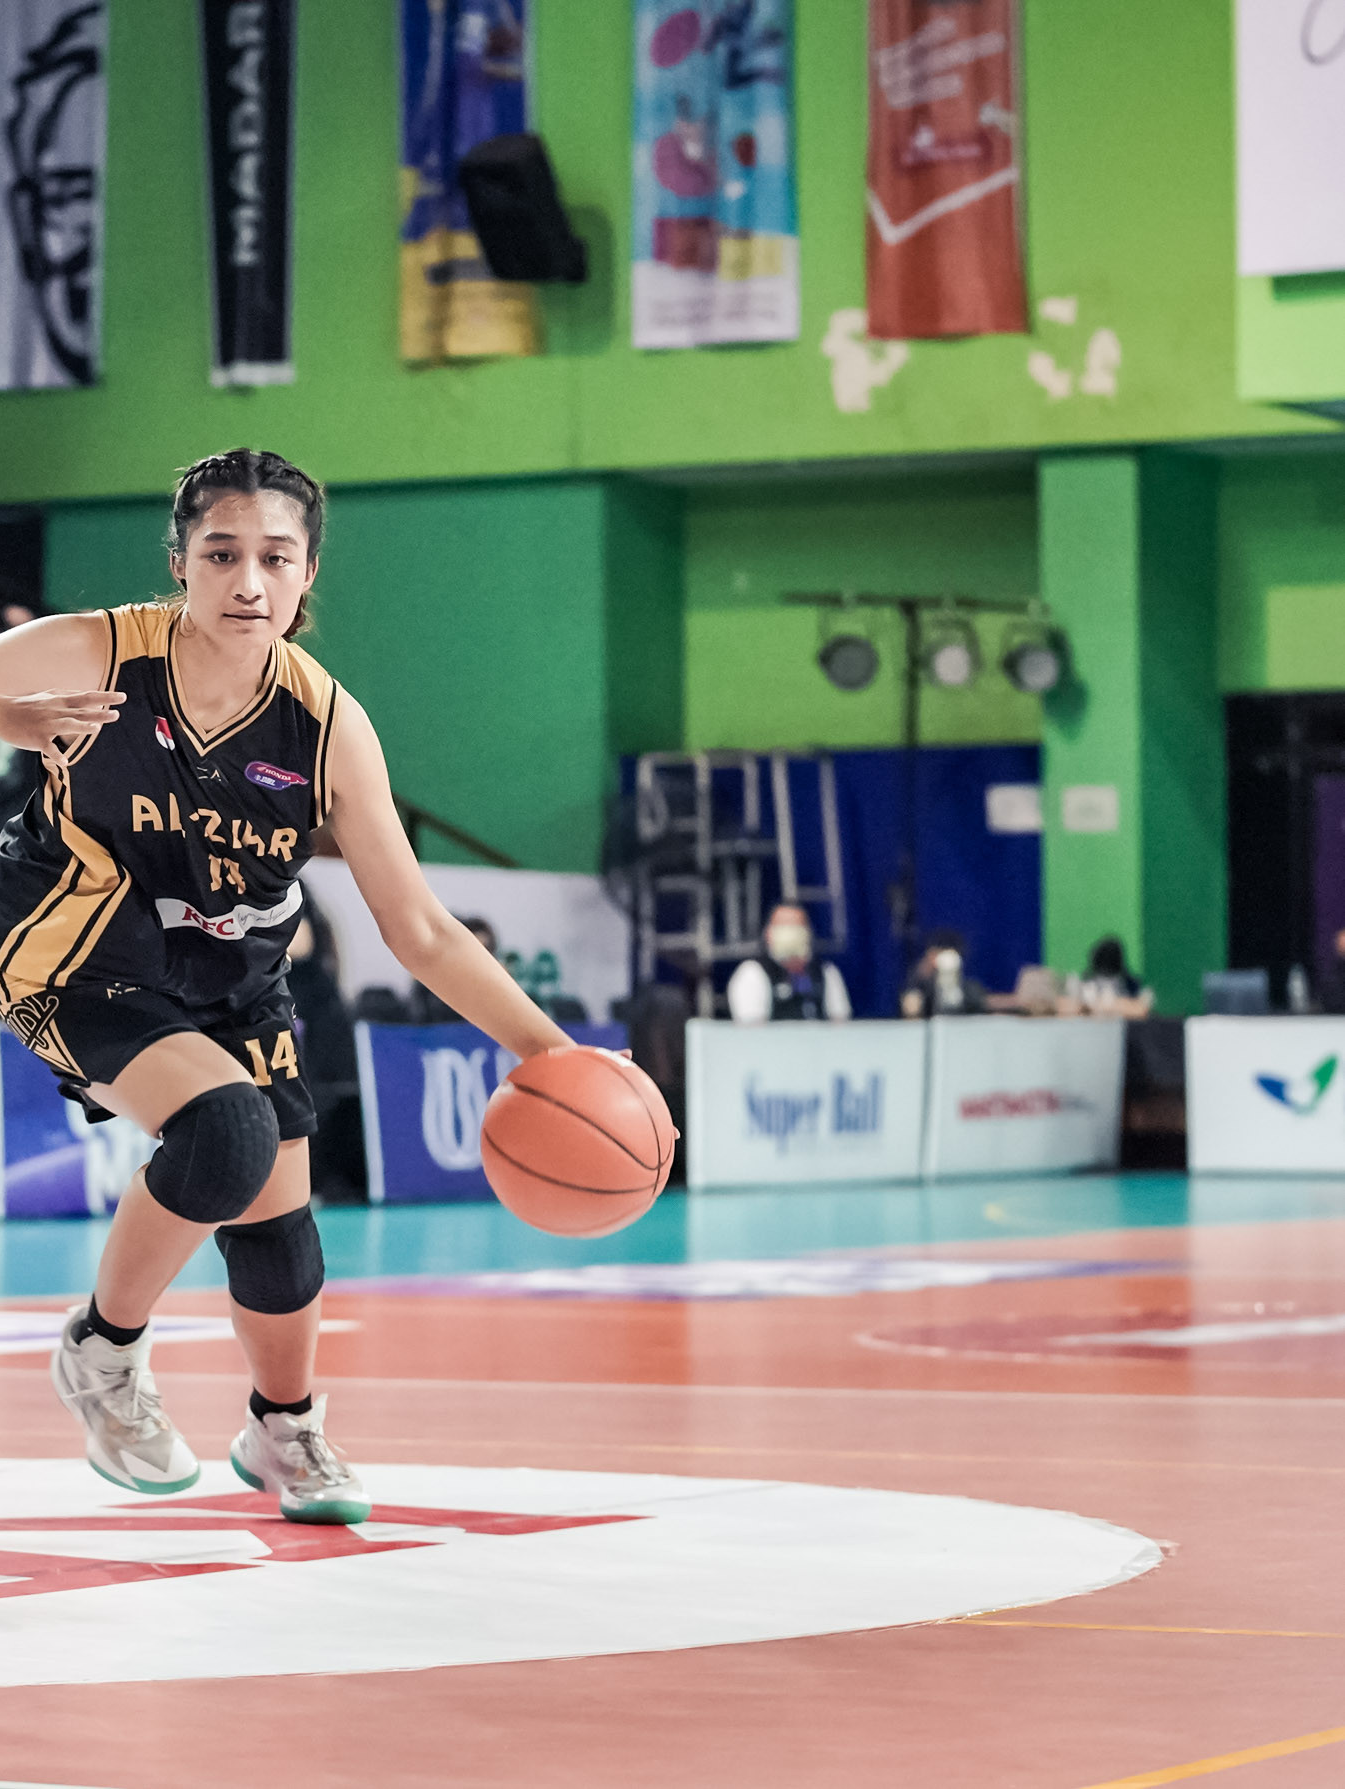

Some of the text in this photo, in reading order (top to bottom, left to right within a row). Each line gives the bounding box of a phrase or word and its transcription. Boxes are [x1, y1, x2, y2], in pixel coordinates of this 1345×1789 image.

[264, 768, 292, 781] HONDA
[181, 906, 235, 936] KFC
[244, 1029, 299, 1087] 14
